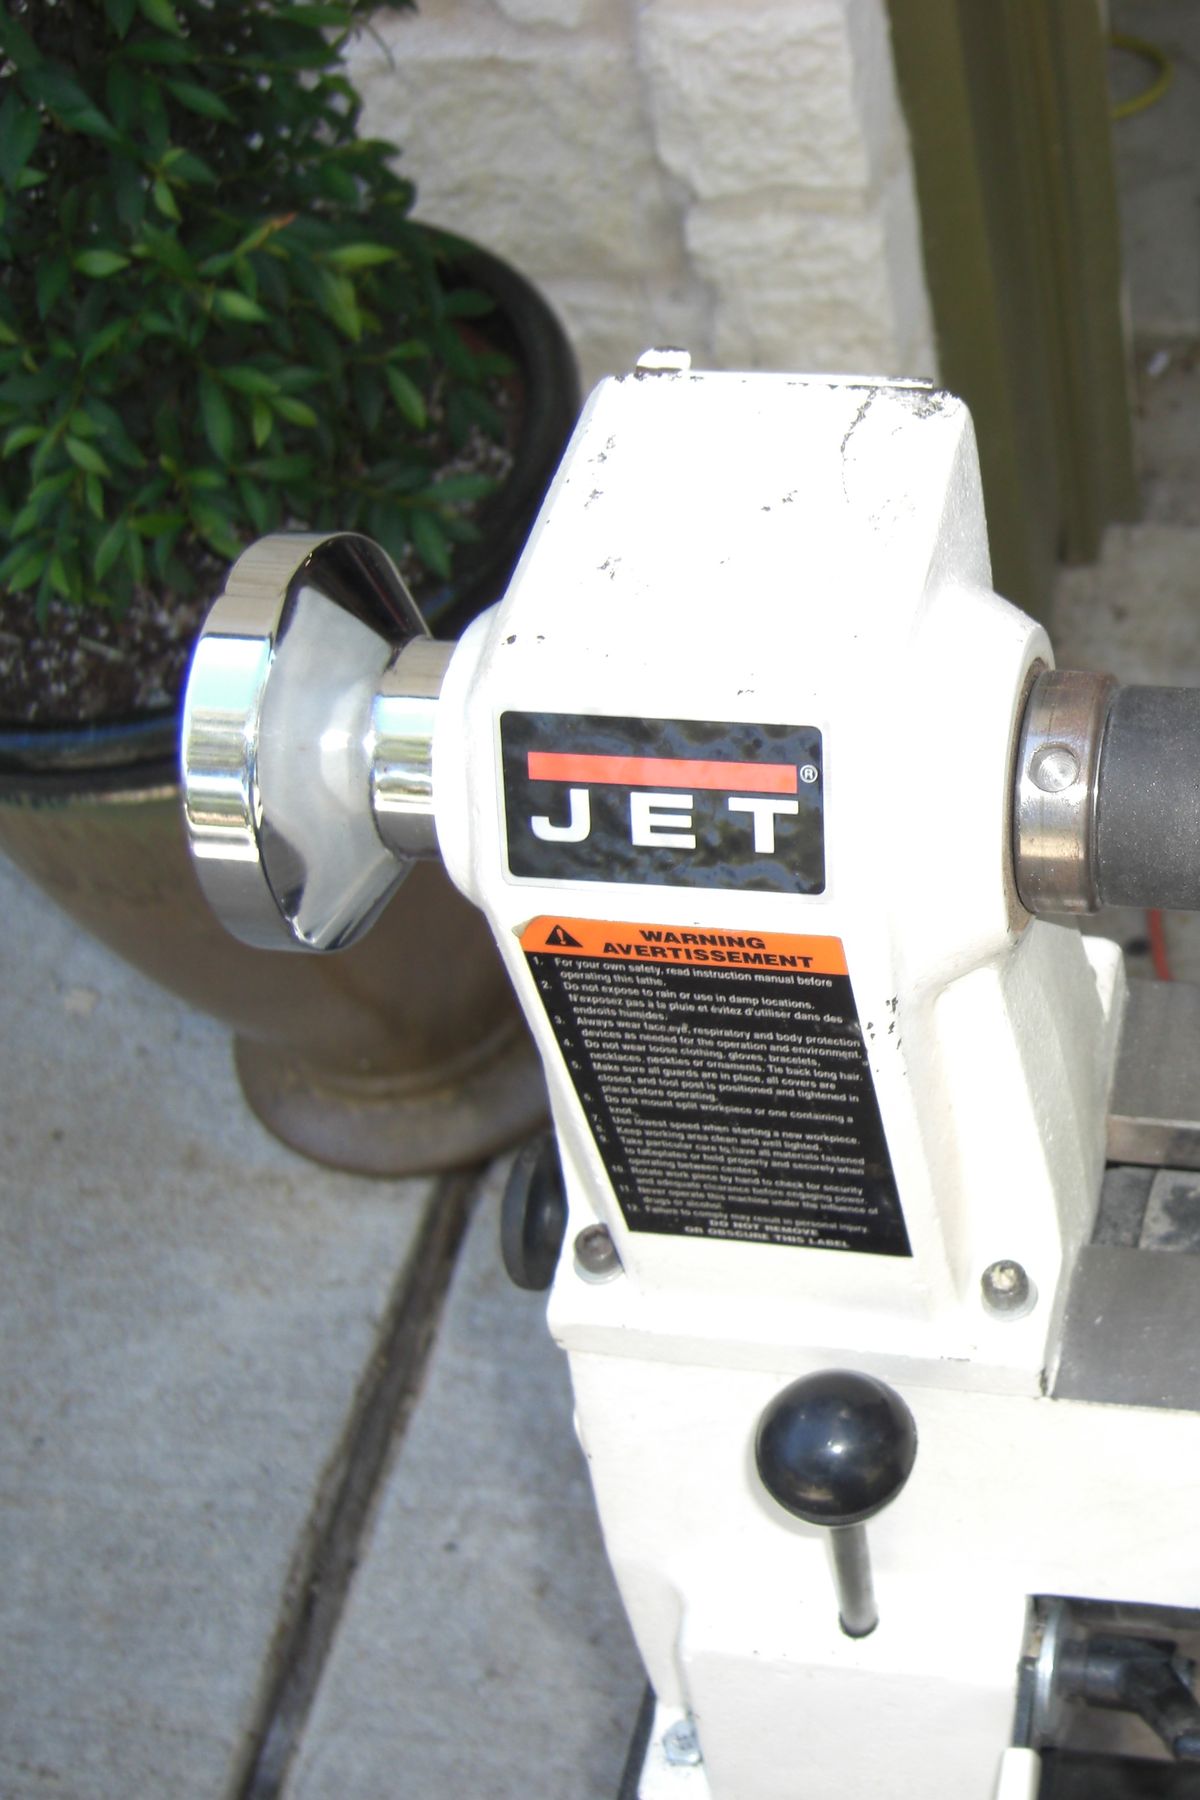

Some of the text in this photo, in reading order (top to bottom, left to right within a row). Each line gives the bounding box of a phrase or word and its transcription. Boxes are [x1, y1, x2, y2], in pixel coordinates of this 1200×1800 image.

[531, 788, 799, 854] JET
[639, 929, 766, 950] WARNING
[603, 942, 813, 968] AVERTISSEMENT
[554, 957, 574, 967] For
[576, 960, 601, 969] your
[602, 962, 626, 971] own
[665, 967, 691, 976] read
[692, 967, 752, 981] instruction
[754, 974, 795, 984] manual
[796, 975, 833, 987] before
[560, 971, 612, 983] operating
[613, 973, 633, 983] this
[563, 981, 579, 991] Do
[581, 983, 599, 992] not
[601, 985, 639, 995] expose
[656, 989, 677, 998] rain
[679, 991, 691, 999] or
[694, 992, 713, 1001] use
[715, 993, 726, 1002] in
[728, 994, 760, 1006] damp
